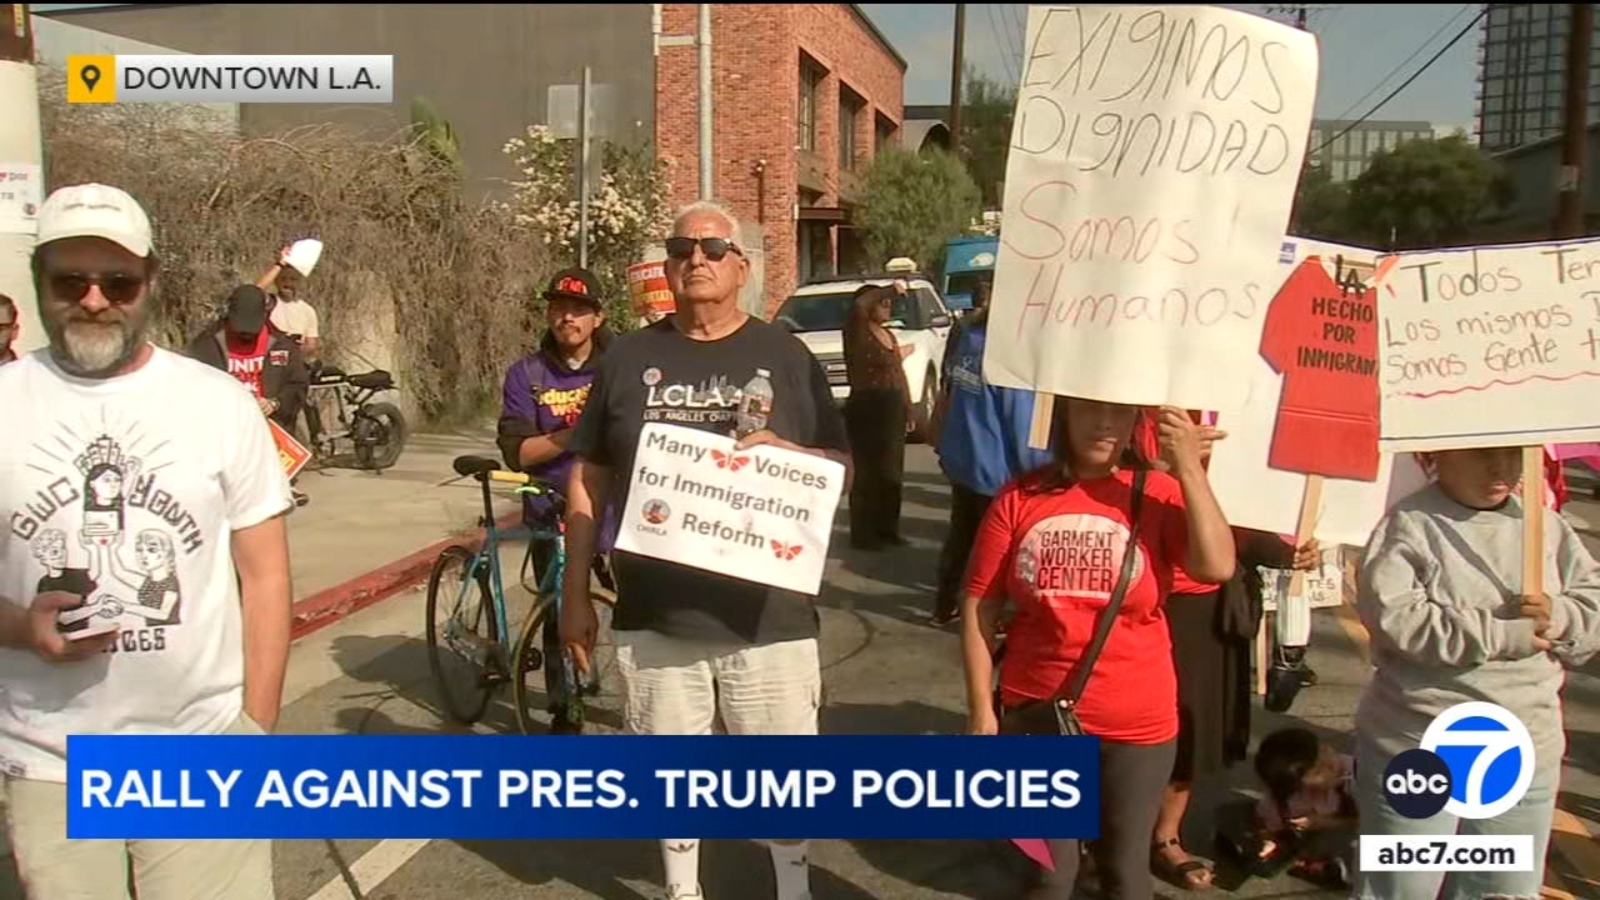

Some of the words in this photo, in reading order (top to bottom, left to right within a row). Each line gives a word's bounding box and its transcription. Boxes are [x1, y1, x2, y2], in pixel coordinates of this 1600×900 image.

[1400, 250, 1522, 302] Todos
[1312, 297, 1373, 323] HECHO
[1385, 317, 1441, 347] Los
[1457, 304, 1573, 334] mismos
[1323, 322, 1355, 344] POR
[665, 410, 706, 422] ANGELES
[646, 432, 707, 462] Many
[755, 455, 827, 490] Voices
[11, 476, 80, 540] GWC
[638, 466, 669, 486] for
[674, 474, 810, 521] Immigration
[681, 512, 764, 549] Reform
[1041, 530, 1114, 548] GARMENT
[1040, 548, 1113, 567] WORKER
[1037, 567, 1113, 591] CENTER
